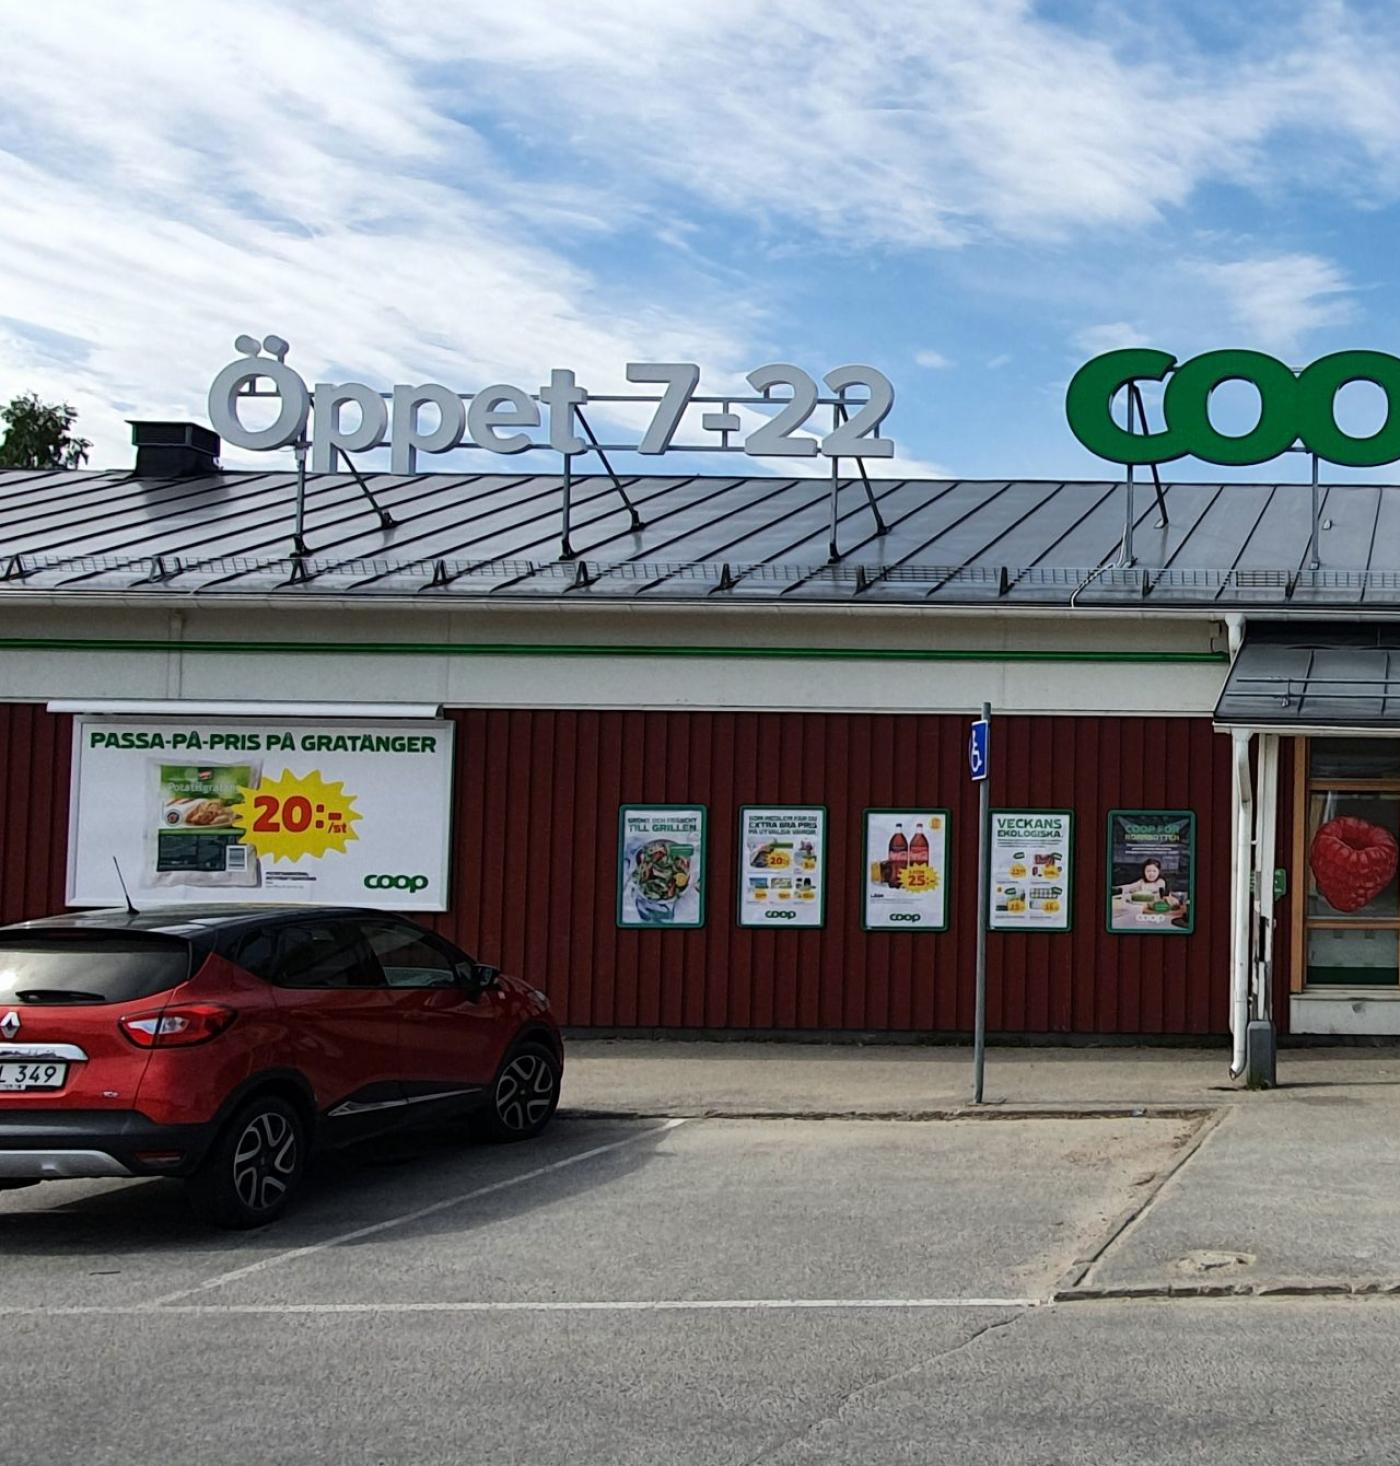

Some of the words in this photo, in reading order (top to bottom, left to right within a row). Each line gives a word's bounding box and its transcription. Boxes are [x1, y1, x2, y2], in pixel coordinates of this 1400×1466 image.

[208, 334, 587, 475] Öppet
[626, 362, 896, 458] 7-22
[90, 731, 261, 751] PASSA-PÅ-PRIS
[266, 732, 295, 751] PÅ
[300, 734, 437, 753] GRATÄNGER
[629, 824, 649, 832] TILL
[652, 824, 697, 832] GRILLEN
[997, 818, 1062, 829] VECKANS
[363, 874, 429, 893] coop
[765, 910, 796, 919] coop
[889, 914, 921, 923] coop
[15, 1065, 57, 1083] 349
